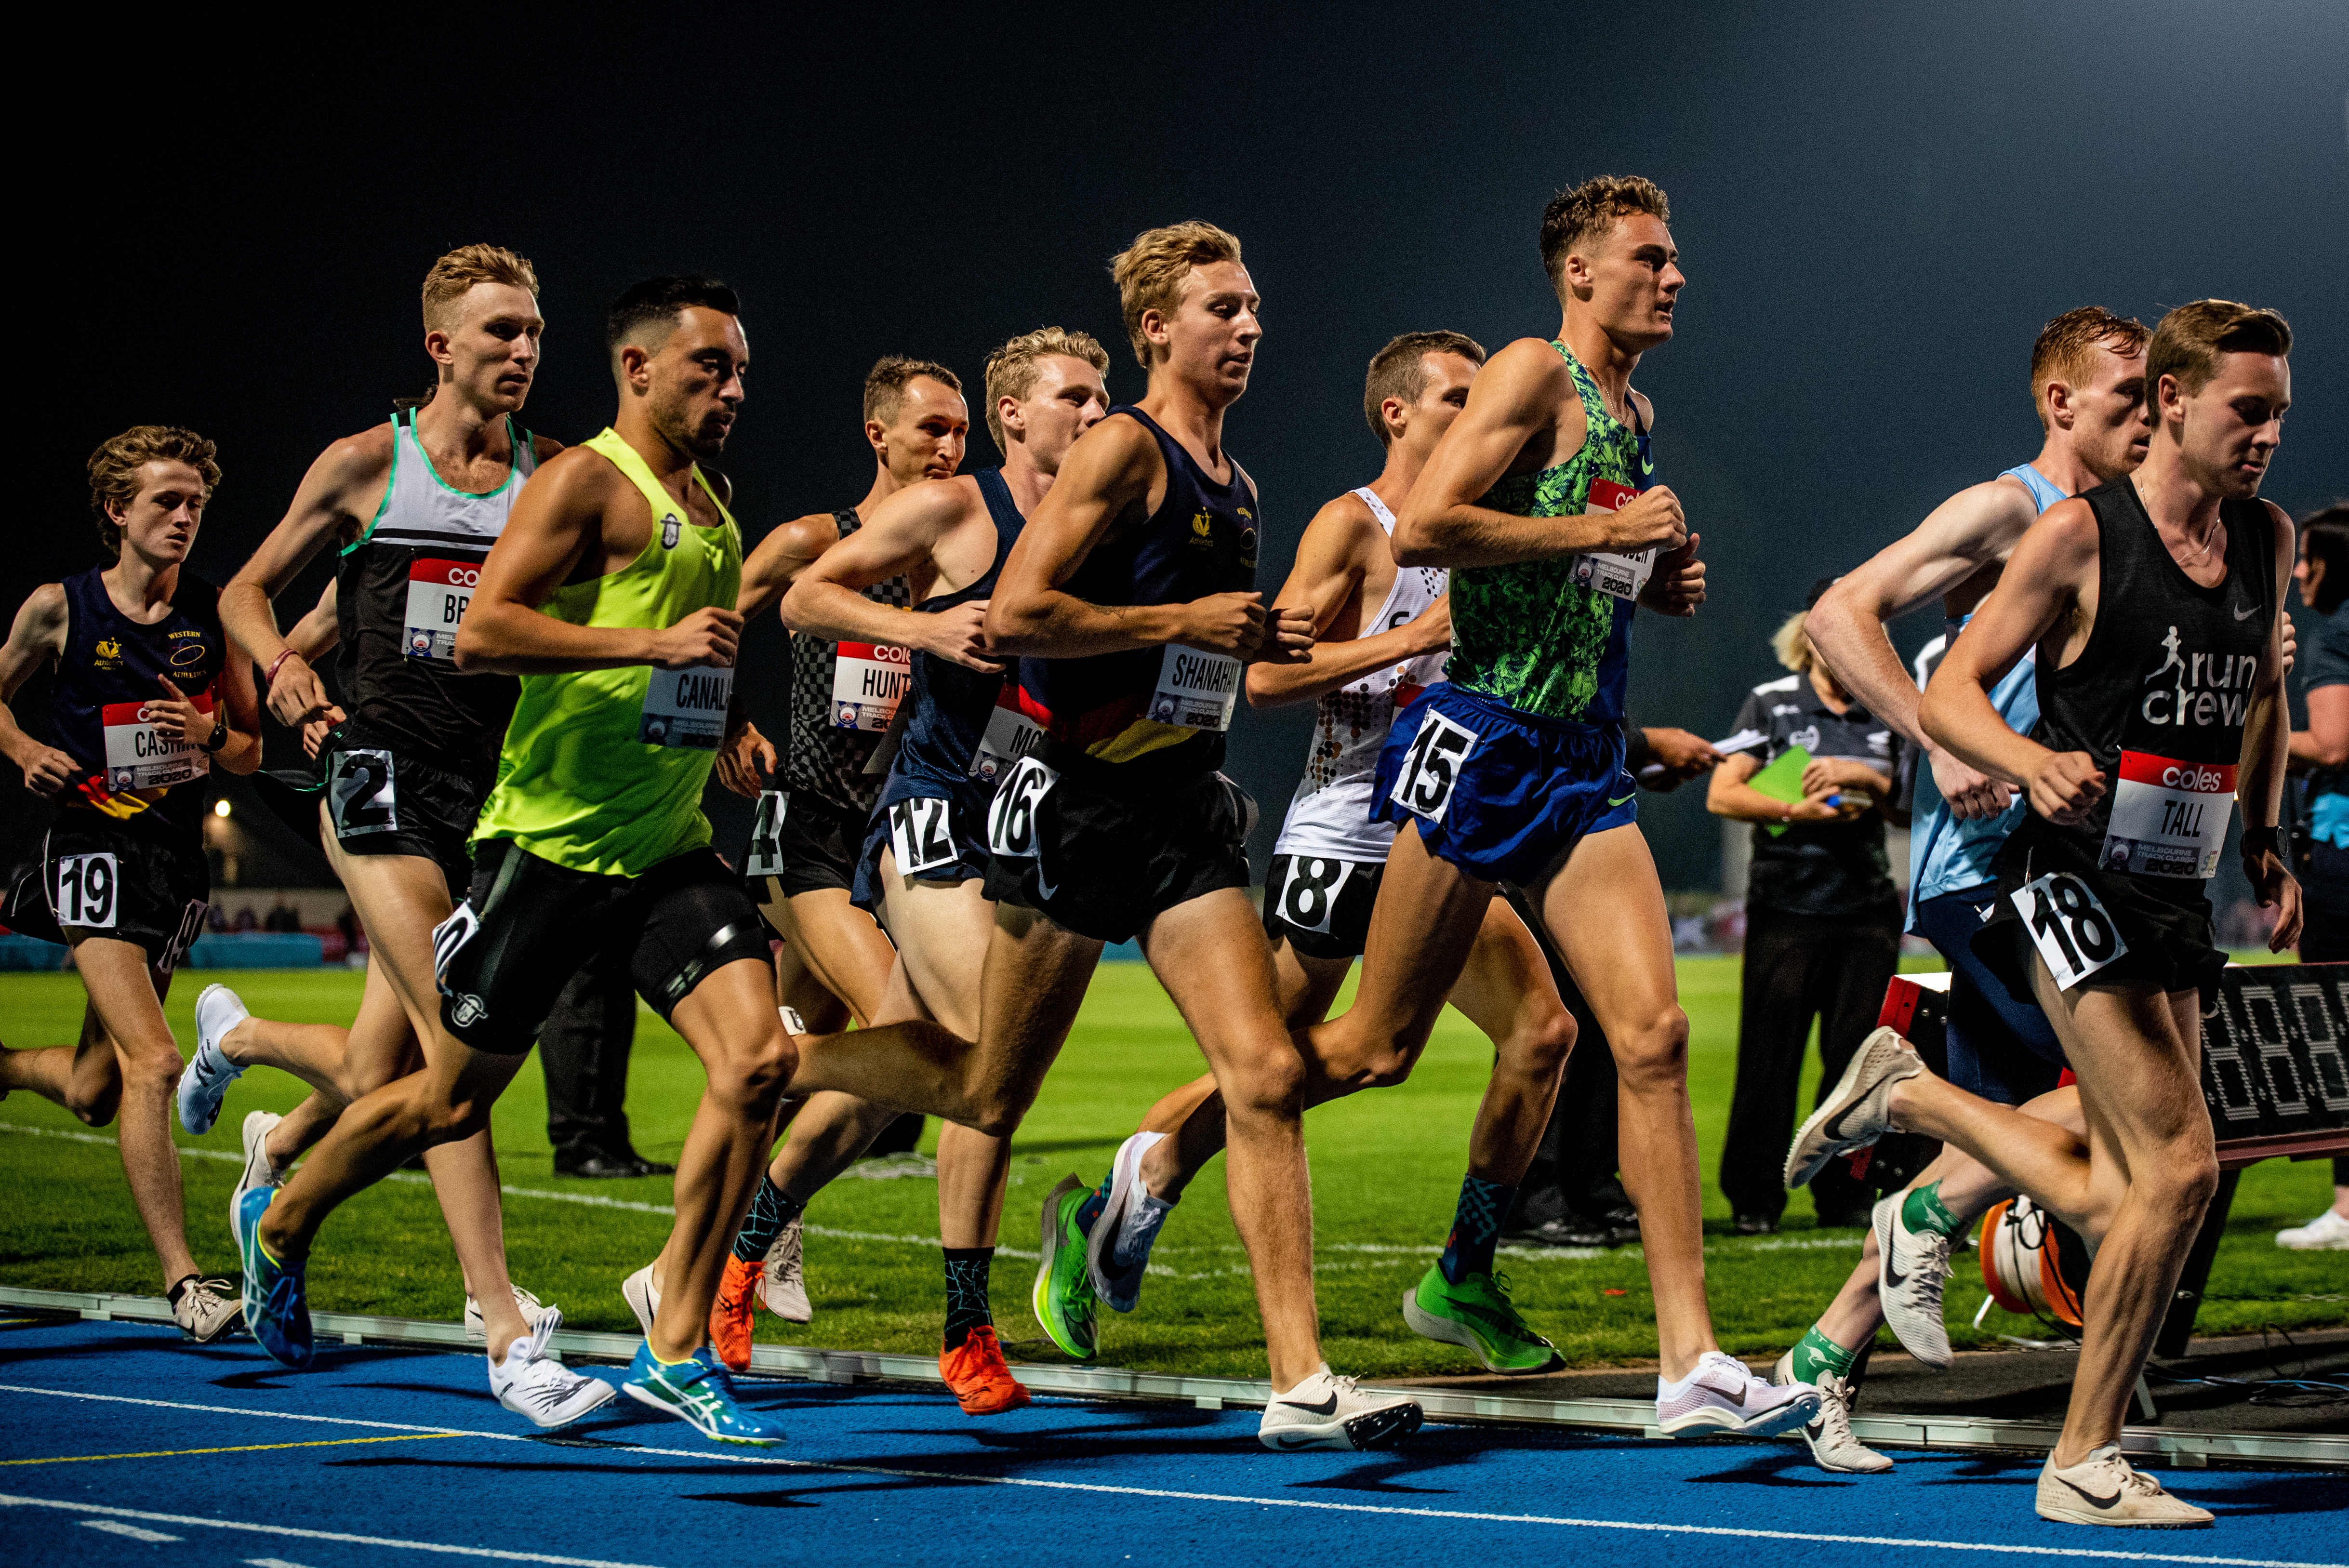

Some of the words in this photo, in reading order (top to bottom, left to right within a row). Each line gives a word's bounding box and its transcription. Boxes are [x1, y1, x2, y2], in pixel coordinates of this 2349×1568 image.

[1602, 576, 1632, 596] 2020
[168, 630, 201, 639] WESTERN
[2192, 652, 2257, 689] run
[676, 674, 730, 711] CANAL
[2142, 690, 2247, 726] crew
[1185, 712, 1221, 727] 2020
[148, 769, 192, 785] 2020
[1401, 718, 1469, 813] 15
[337, 753, 389, 831] 2
[992, 762, 1046, 853] 16
[893, 798, 954, 868] 12
[2161, 799, 2204, 837] TALL
[2144, 858, 2197, 876] 2020
[61, 857, 114, 924] 19
[1286, 855, 1342, 928] 8
[2031, 876, 2116, 977] 18
